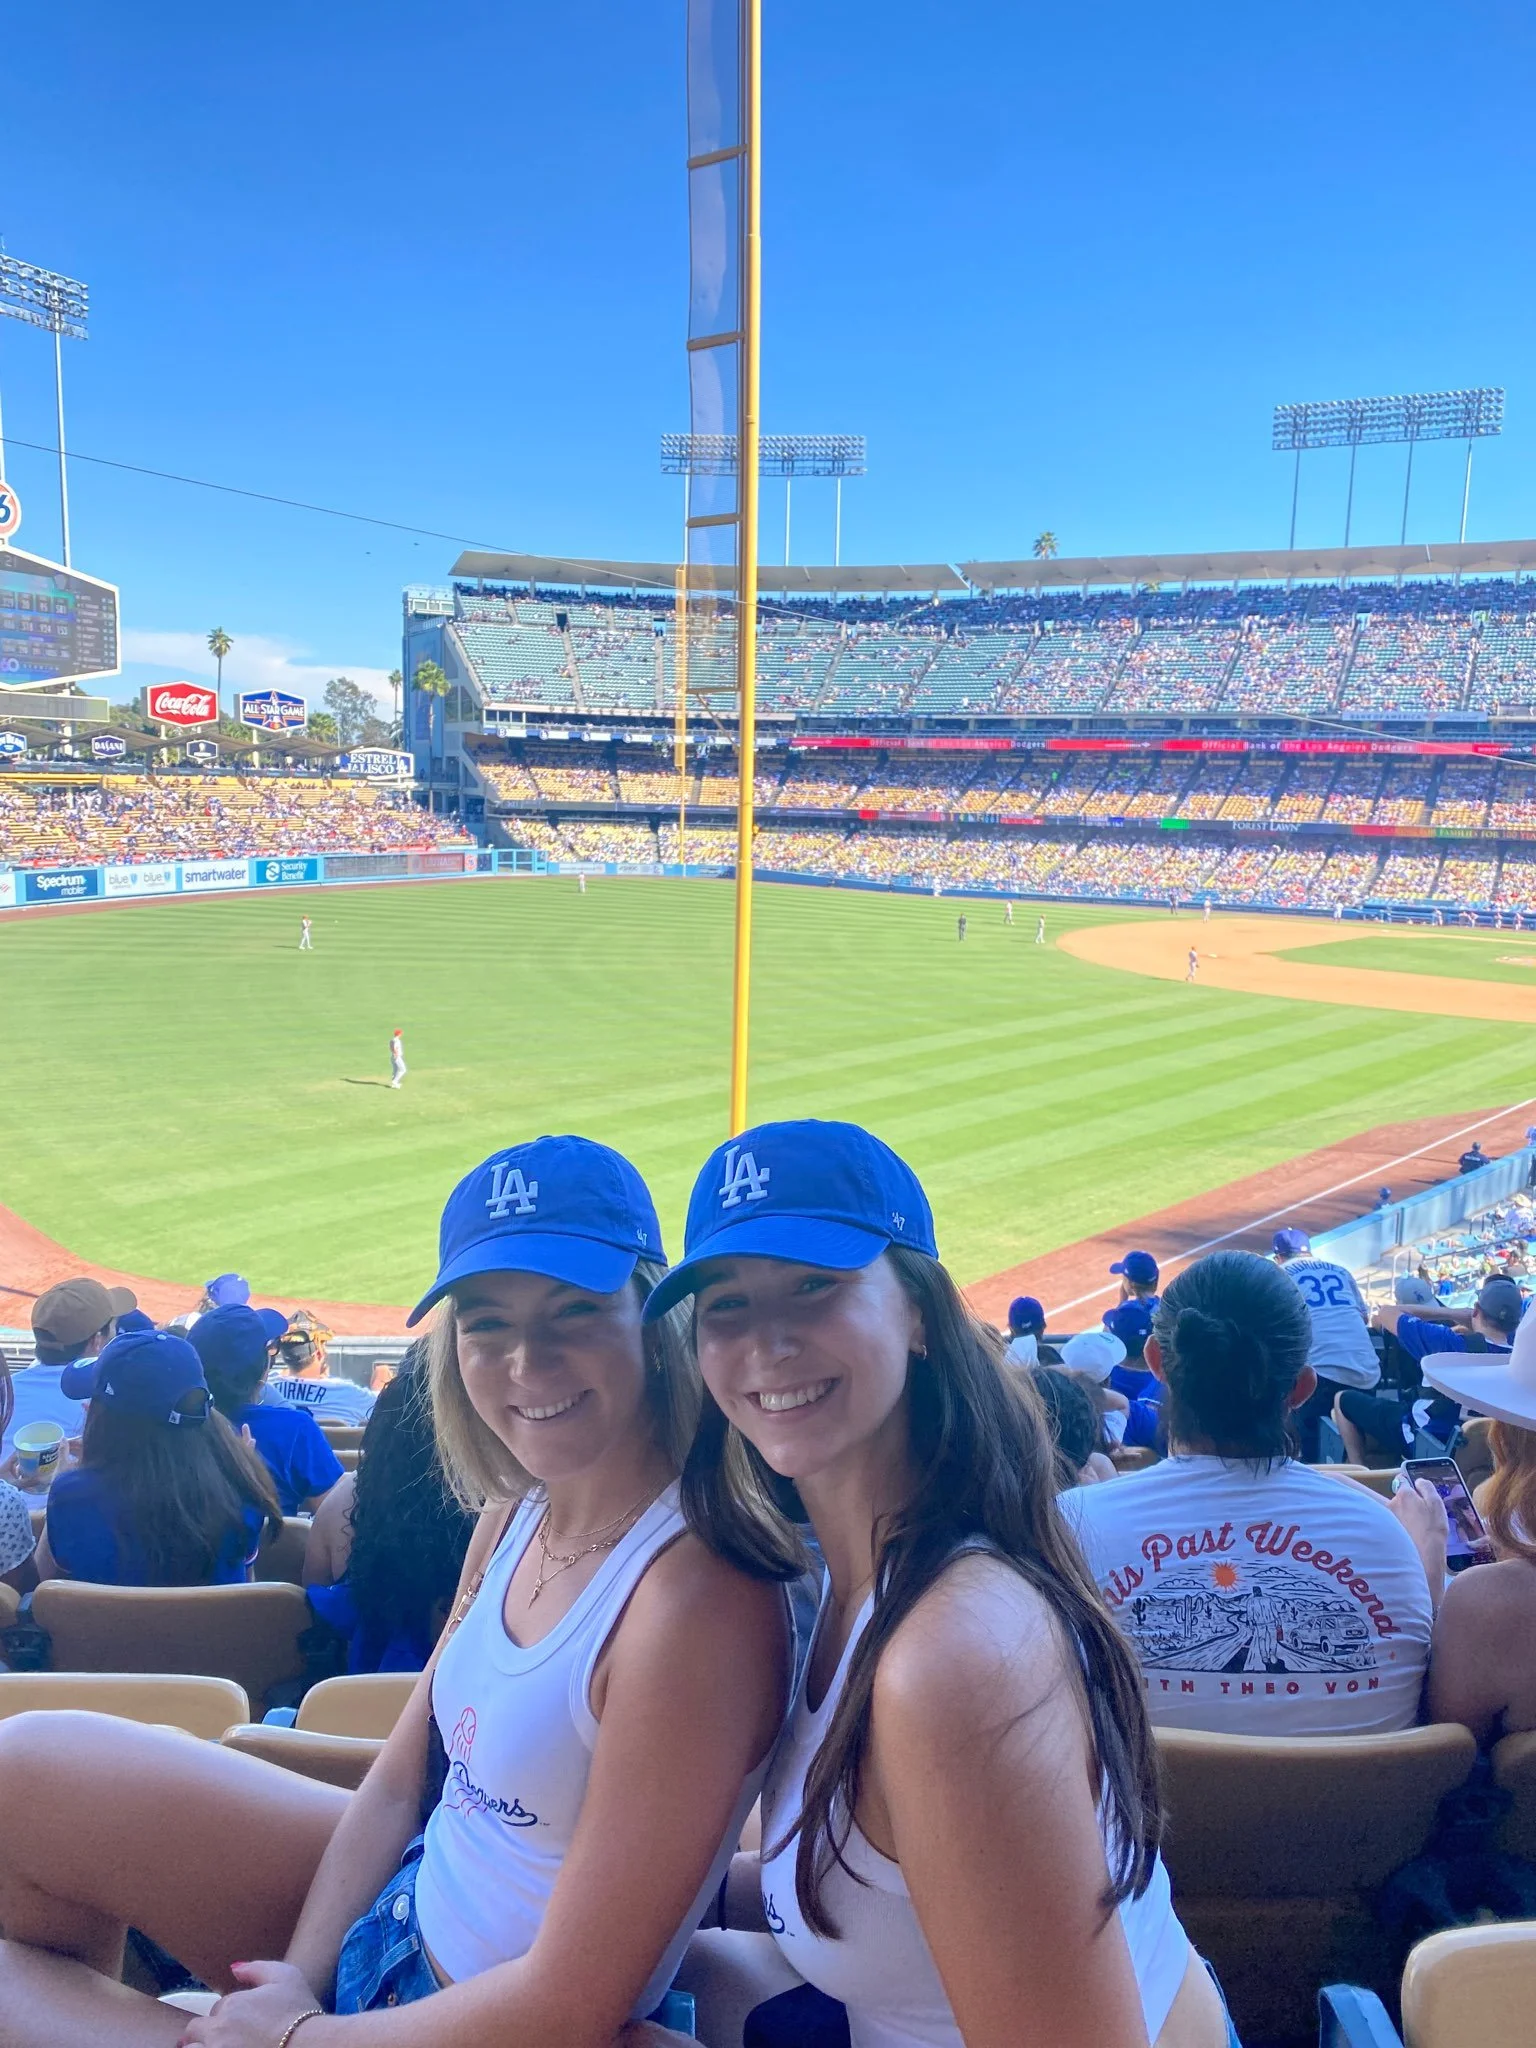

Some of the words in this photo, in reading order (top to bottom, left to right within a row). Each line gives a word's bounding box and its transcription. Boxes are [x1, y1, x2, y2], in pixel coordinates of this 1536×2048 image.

[244, 703, 260, 714] ALL
[261, 702, 280, 715] STAR
[280, 703, 304, 716] GAME
[95, 741, 123, 751] DASANI
[1010, 740, 1046, 749] Dodgers
[1201, 741, 1240, 749] Official
[347, 763, 395, 774] JALISCO
[1232, 821, 1267, 830] FOREST
[1269, 821, 1299, 831] LAWN
[1481, 830, 1499, 839] FOR
[281, 862, 308, 872] Security
[109, 873, 129, 885] blue
[143, 872, 162, 882] blue
[185, 868, 247, 883] smartwater
[281, 871, 305, 880] Benefit
[36, 874, 84, 891] Spectrum
[718, 1145, 770, 1210] LA
[485, 1160, 539, 1220] LA
[1284, 1260, 1346, 1276] ODRIGUE
[1297, 1274, 1352, 1308] 32
[1141, 1522, 1237, 1573] Past
[1245, 1521, 1402, 1640] Weekend
[1220, 1681, 1300, 1695] THEO
[1325, 1676, 1380, 1695] VON
